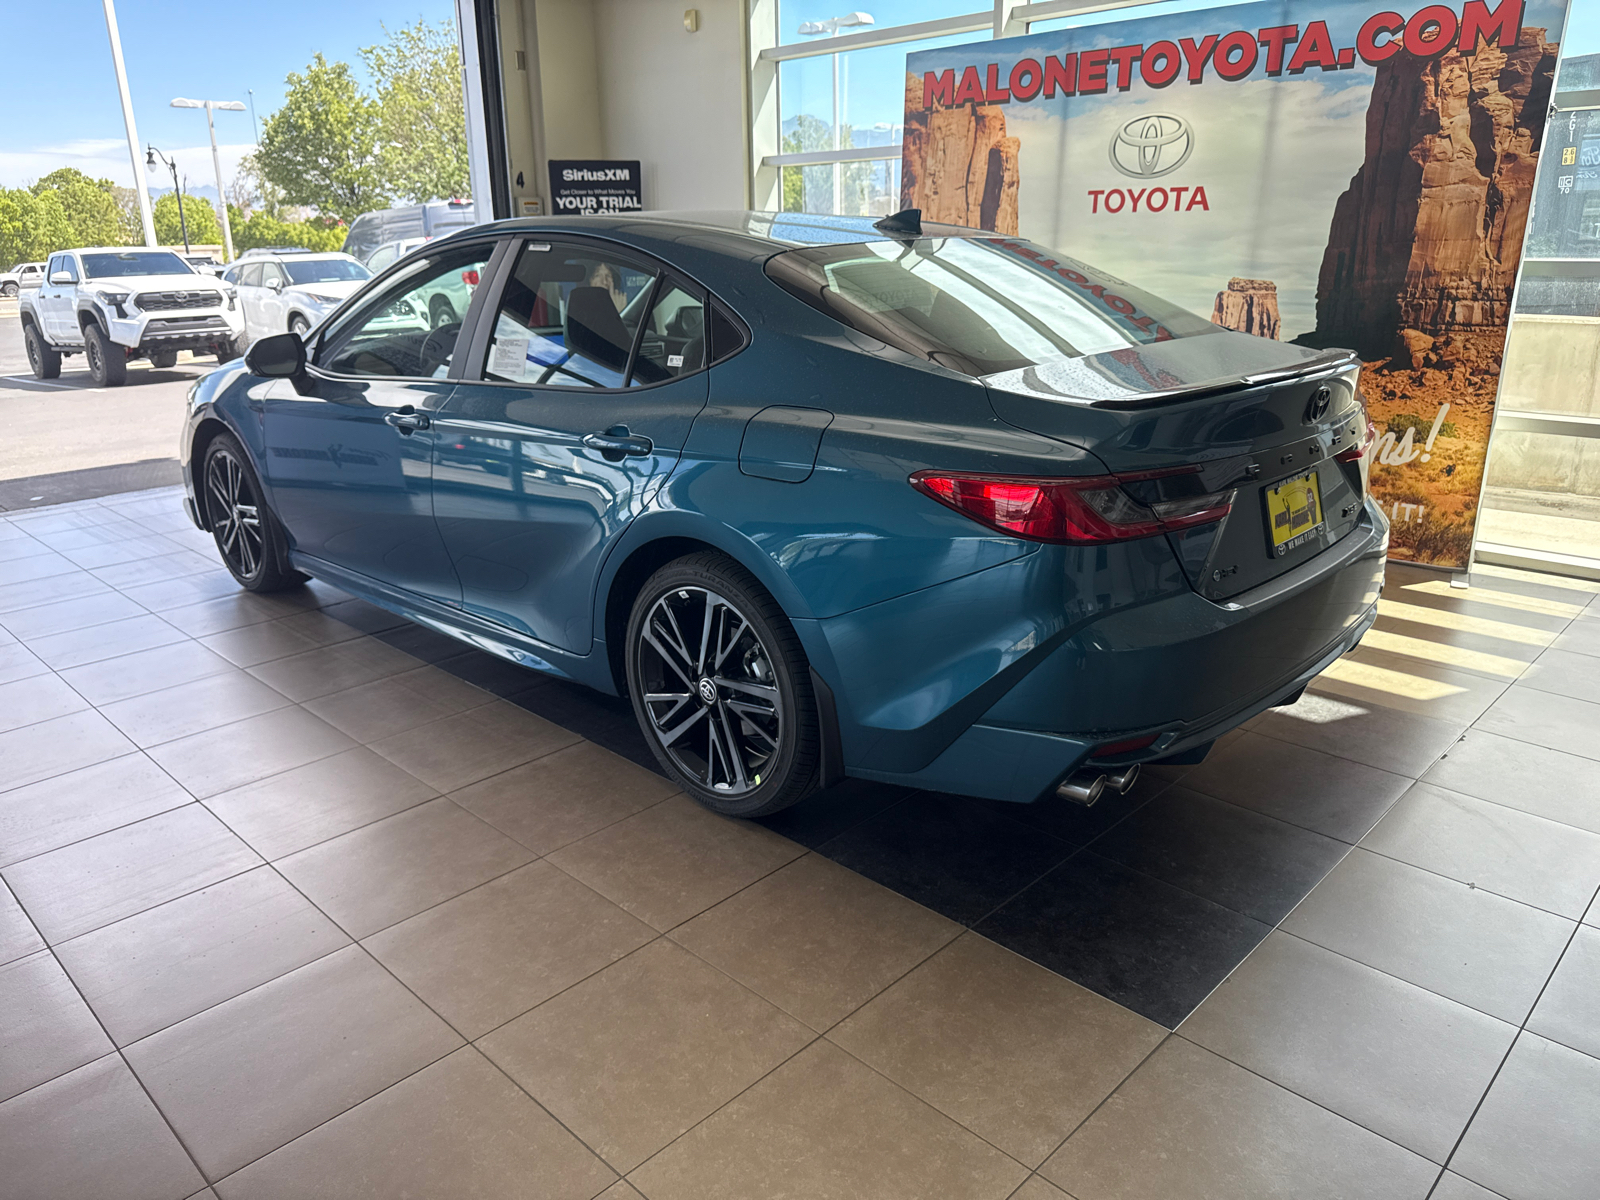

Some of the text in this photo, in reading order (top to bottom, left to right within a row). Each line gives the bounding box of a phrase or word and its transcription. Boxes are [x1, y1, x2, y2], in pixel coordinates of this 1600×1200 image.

[922, 0, 1525, 109] MALONETOYOTA.COM
[516, 171, 525, 189] 4
[562, 168, 630, 181] SiriusXM
[555, 196, 642, 209] YOUR TRIAL
[1087, 186, 1210, 214] TOYOTA
[1391, 502, 1425, 524] IT!
